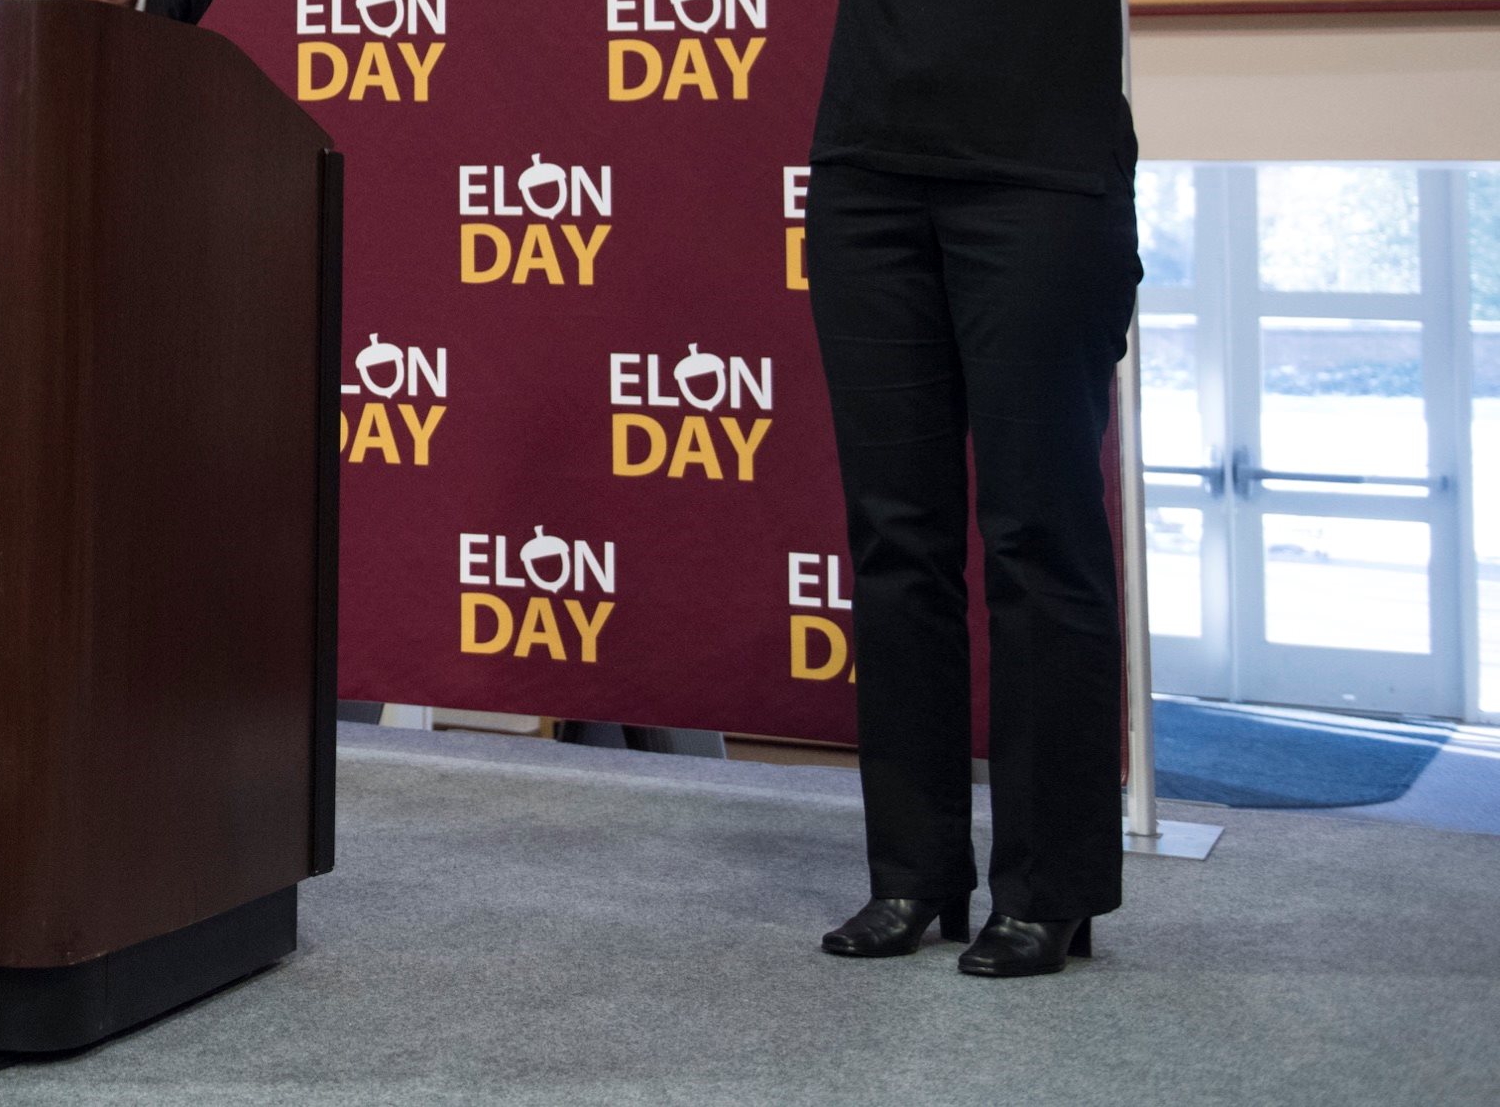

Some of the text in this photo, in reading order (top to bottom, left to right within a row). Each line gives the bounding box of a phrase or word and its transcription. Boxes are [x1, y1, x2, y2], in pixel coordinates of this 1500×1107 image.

[297, 41, 446, 102] DAY
[608, 37, 767, 102] DAY
[459, 153, 612, 220] ELON
[460, 223, 612, 286] DAY
[611, 343, 772, 412] ELON
[340, 402, 447, 466] AY
[612, 413, 772, 481] DAY
[459, 525, 615, 594] ELON
[460, 592, 615, 663] DAY
